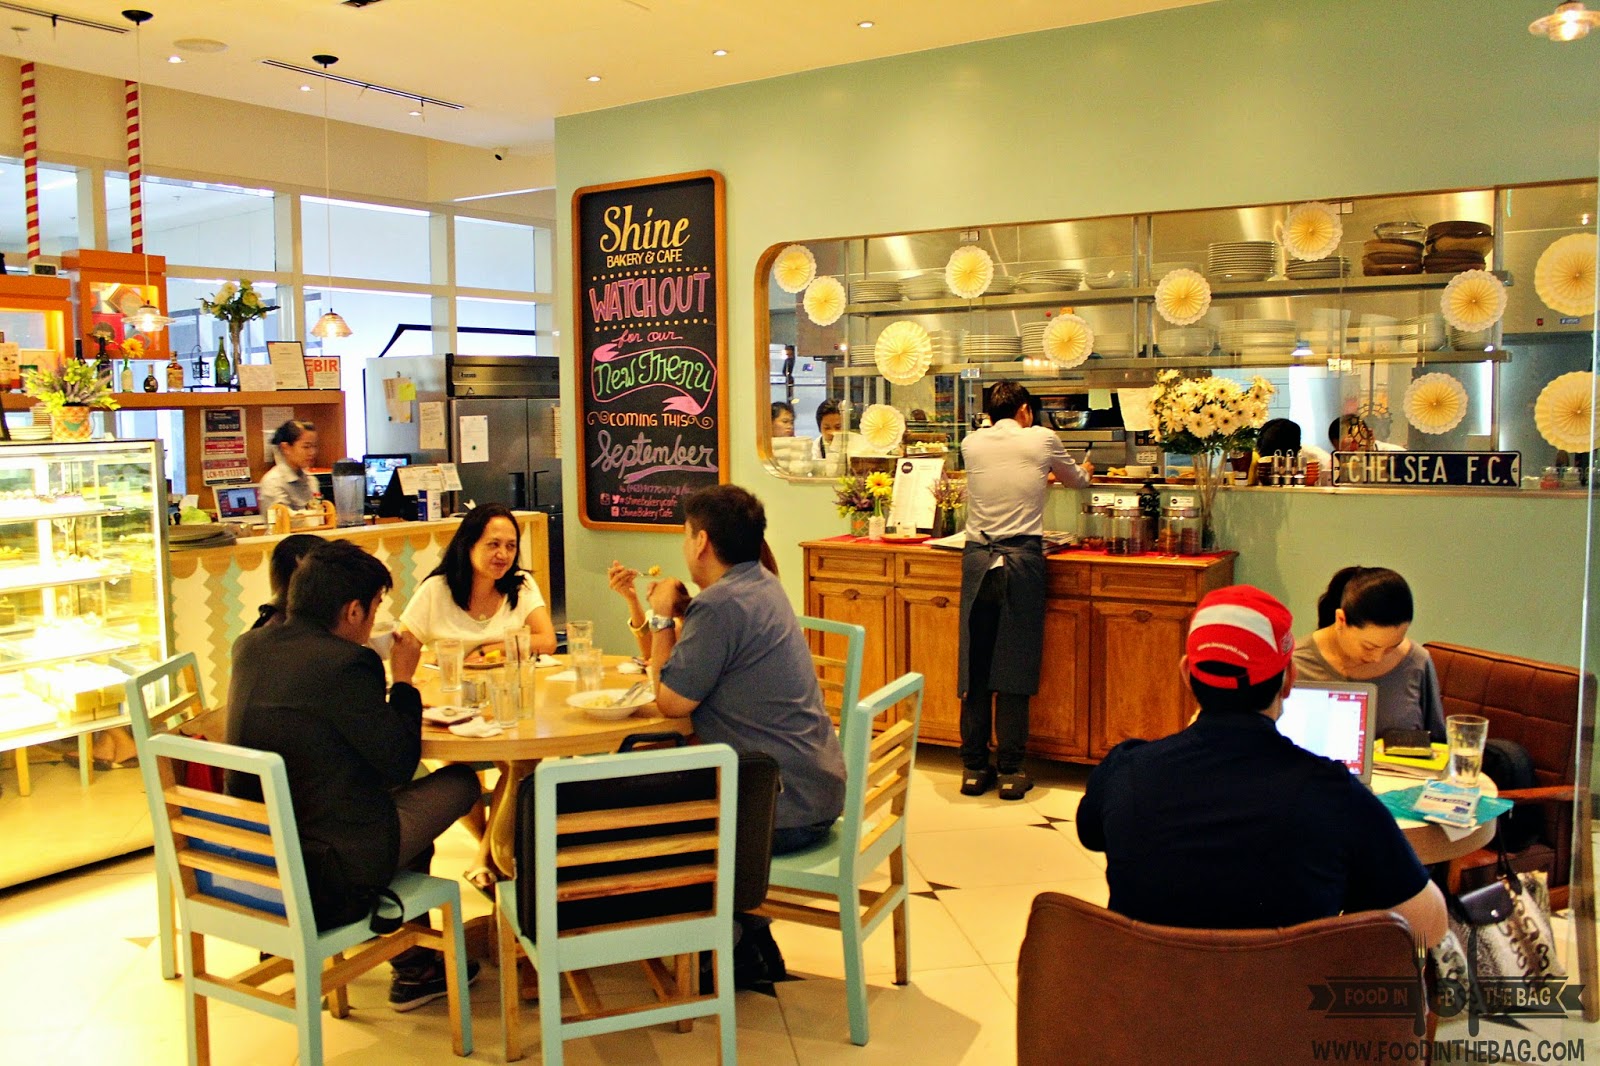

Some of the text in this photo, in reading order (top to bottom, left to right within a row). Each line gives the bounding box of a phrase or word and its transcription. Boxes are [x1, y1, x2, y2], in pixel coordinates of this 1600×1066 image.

[600, 205, 690, 252] Shine
[606, 248, 683, 268] BAKERY & CAFE
[589, 272, 711, 323] WATCH OUT
[611, 329, 683, 348] for our
[314, 359, 338, 372] BIR
[609, 413, 689, 427] COMING THIS
[591, 429, 716, 480] September
[1348, 455, 1508, 484] CHELSEA F.C.
